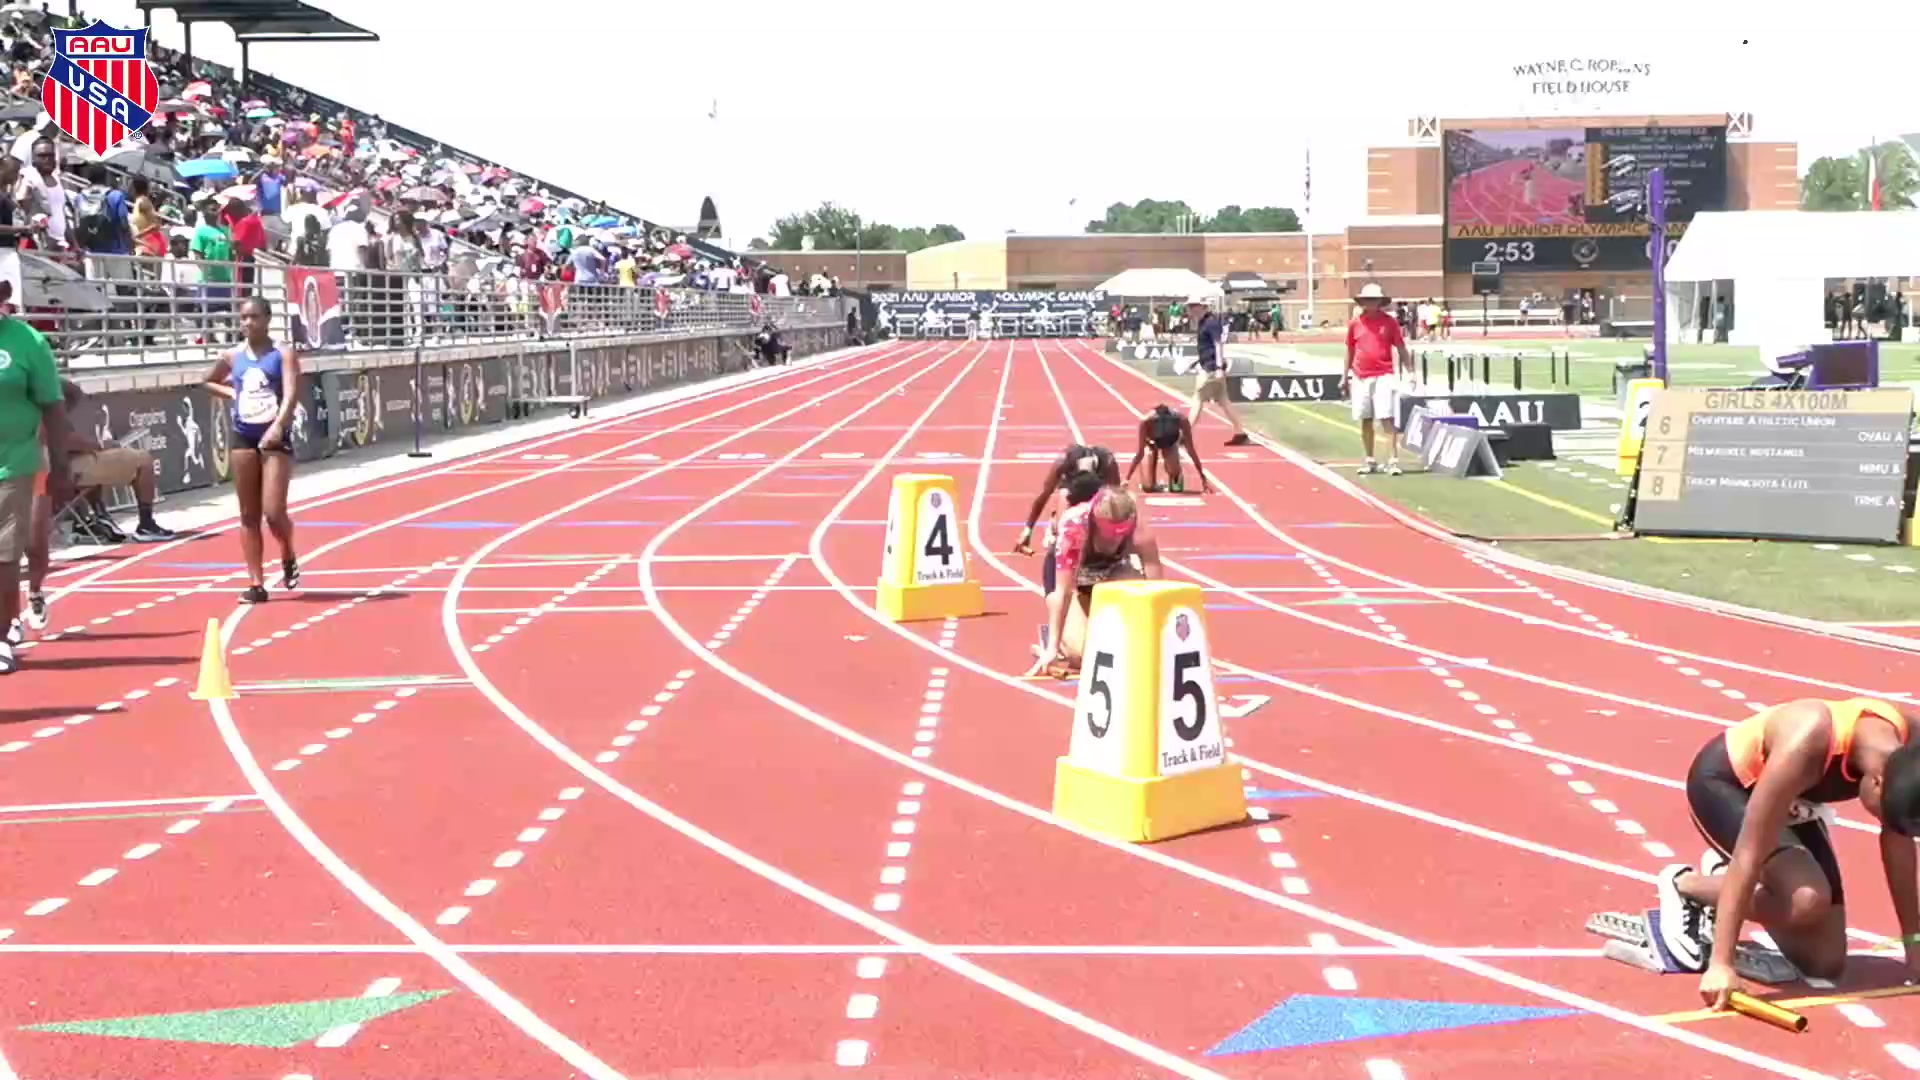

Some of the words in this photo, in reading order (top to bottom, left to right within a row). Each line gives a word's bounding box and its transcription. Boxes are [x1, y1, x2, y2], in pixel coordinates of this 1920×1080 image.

[1532, 81, 1577, 95] FIELD
[1580, 80, 1630, 94] HOUSE
[1483, 241, 1535, 262] 2:53
[871, 291, 899, 303] 2021
[902, 291, 928, 303] AAU
[932, 291, 977, 303] JUNIOR
[1001, 290, 1056, 302] OLYMPIC
[1057, 290, 1105, 302] GAMES
[1267, 378, 1324, 399] AAU
[1705, 392, 1765, 409] GIRLS
[1771, 392, 1849, 410] 4X100M
[1466, 400, 1545, 427] AAU
[1659, 415, 1672, 435] 6
[1894, 431, 1904, 442] A
[1657, 444, 1668, 465] 7
[1652, 475, 1664, 496] 8
[1886, 495, 1897, 506] A
[924, 513, 954, 565] 4
[917, 571, 938, 581] Track
[946, 568, 964, 578] Field
[1087, 650, 1115, 739] 5
[1172, 650, 1207, 742] 5
[1161, 751, 1189, 768] Track
[1189, 748, 1198, 762] &
[1199, 743, 1221, 761] Field
